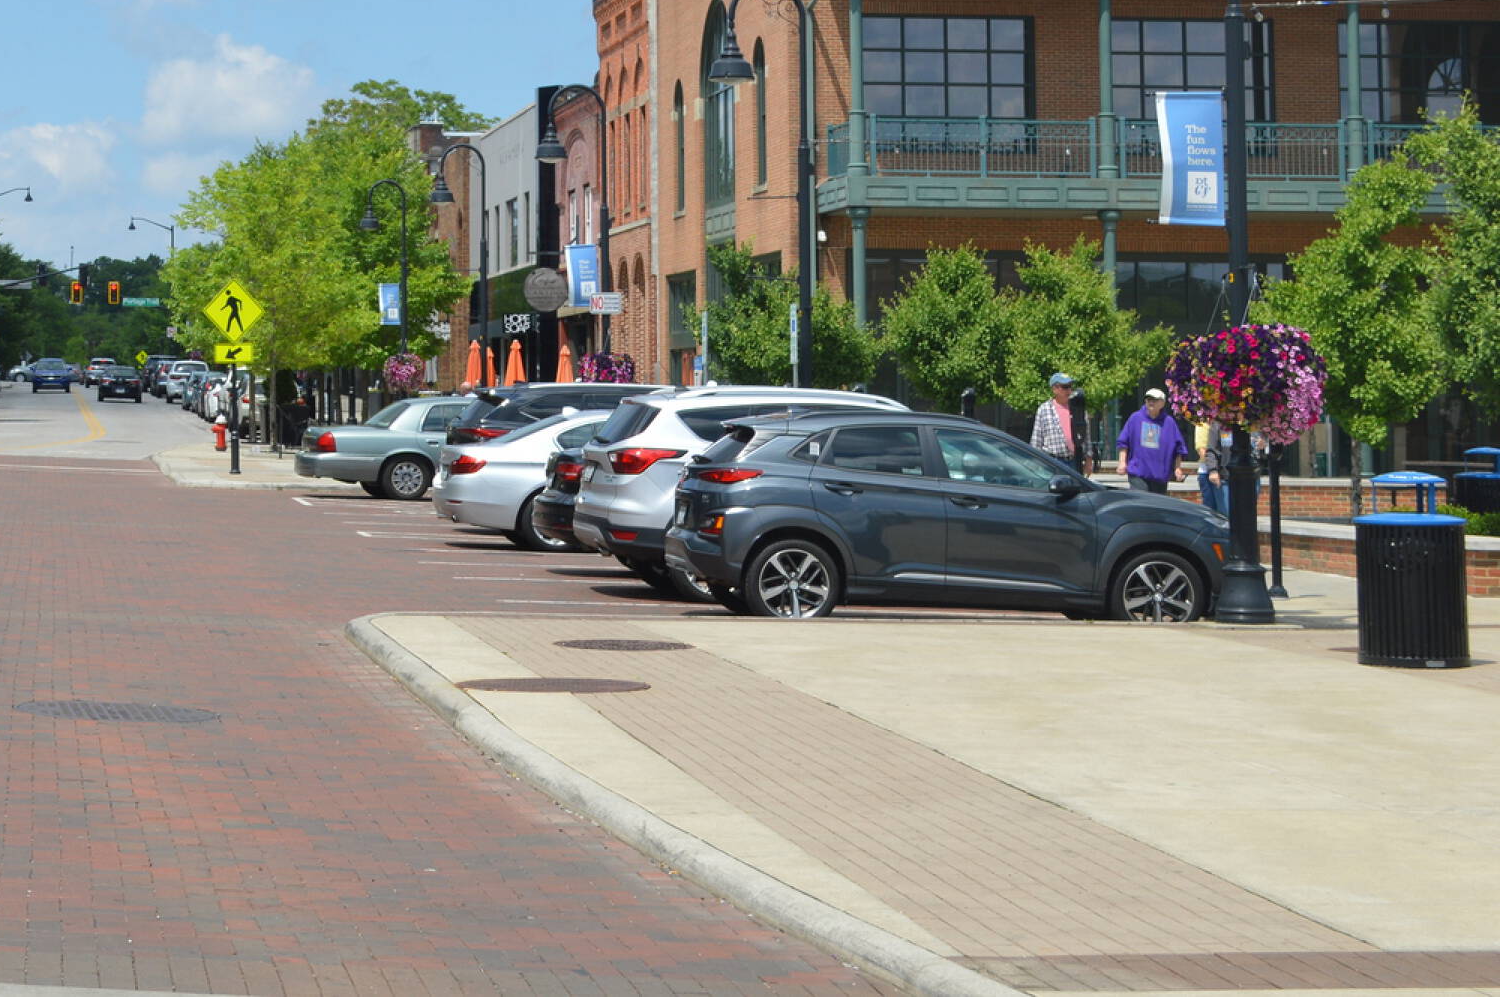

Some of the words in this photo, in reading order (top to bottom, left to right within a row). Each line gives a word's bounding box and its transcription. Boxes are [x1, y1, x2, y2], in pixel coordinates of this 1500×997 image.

[1185, 123, 1207, 134] The
[1187, 134, 1205, 144] fun
[1187, 144, 1217, 155] flows
[1187, 156, 1215, 166] here.
[590, 296, 604, 310] NO
